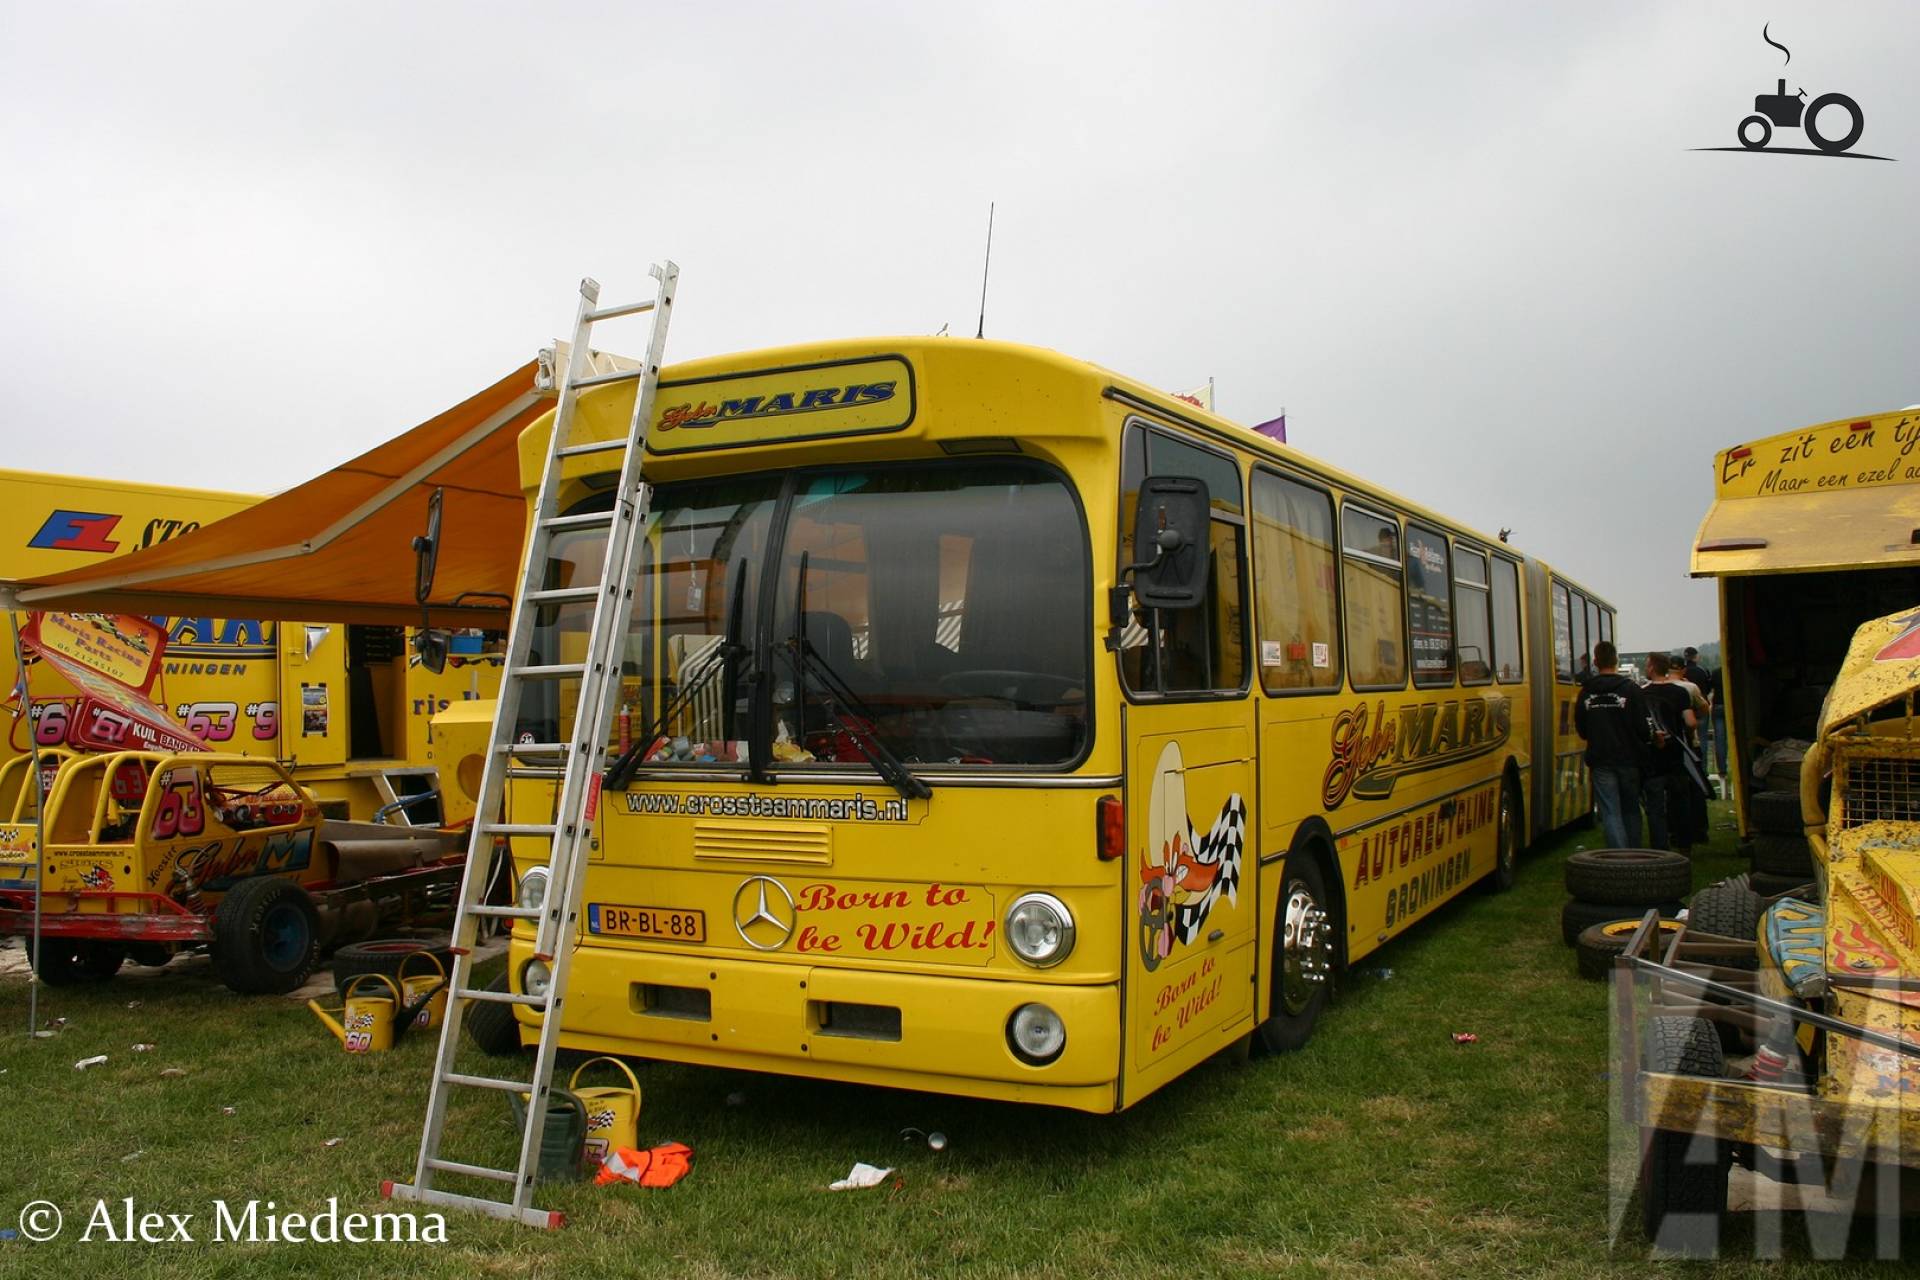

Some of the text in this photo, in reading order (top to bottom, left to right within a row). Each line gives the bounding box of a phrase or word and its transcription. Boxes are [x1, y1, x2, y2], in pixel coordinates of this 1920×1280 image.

[717, 381, 897, 419] MARIS
[1722, 445, 1757, 484] Er
[1780, 434, 1816, 464] zit
[1830, 430, 1876, 453] een
[1758, 469, 1809, 495] Maar
[1818, 474, 1848, 487] een
[1857, 458, 1901, 483] ezel
[50, 614, 144, 668] Maris Racing
[75, 637, 112, 662] Parts
[160, 663, 247, 677] NINGEN
[132, 722, 158, 742] KUIL
[1392, 696, 1513, 765] MARIS
[625, 793, 909, 821] www.crossteammaris.nl
[1354, 787, 1496, 891] AUTORECYCLING
[796, 883, 970, 912] Born to
[1385, 846, 1472, 929] GRONINGEN
[605, 908, 697, 937] BR-BL-88
[797, 921, 996, 952] be Wild!
[1154, 957, 1215, 1016] Born to
[1152, 974, 1222, 1051] be Wild!
